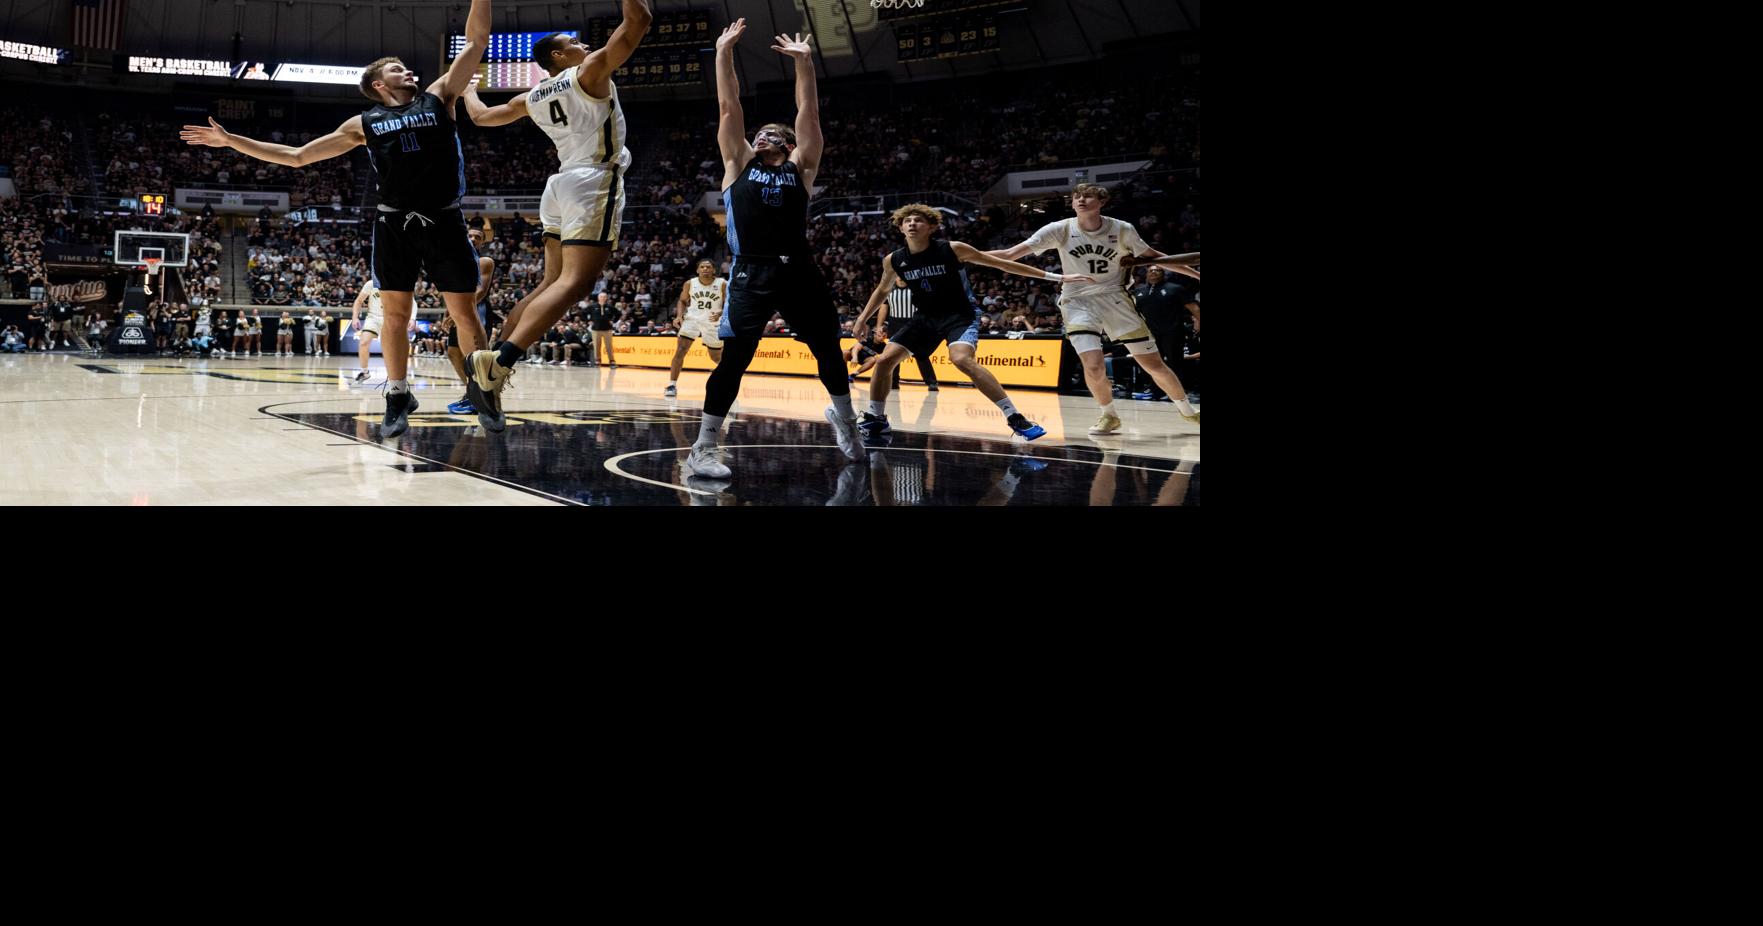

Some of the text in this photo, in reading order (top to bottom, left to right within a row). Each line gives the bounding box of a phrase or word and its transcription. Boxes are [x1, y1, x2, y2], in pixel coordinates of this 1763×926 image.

[658, 24, 674, 34] 23
[676, 23, 691, 33] 37
[695, 21, 708, 31] 19
[899, 26, 997, 50] 50 3 23 15
[129, 56, 230, 71] MEN'S BASKETBALL
[632, 66, 647, 76] 43
[649, 65, 664, 75] 42
[669, 63, 681, 74] 10
[686, 62, 701, 73] 22
[217, 98, 257, 110] PAINT
[549, 99, 568, 127] 4
[371, 112, 438, 136] GRAND VALLEY
[400, 131, 421, 153] 11
[761, 187, 784, 207] 13
[147, 203, 161, 214] 14
[57, 254, 83, 263] TIME
[85, 255, 98, 264] TO
[1068, 243, 1118, 261] PURDUE
[1087, 259, 1109, 274] 12
[698, 300, 712, 310] 24
[754, 349, 785, 359] tinental
[977, 354, 1034, 366] ntinental
